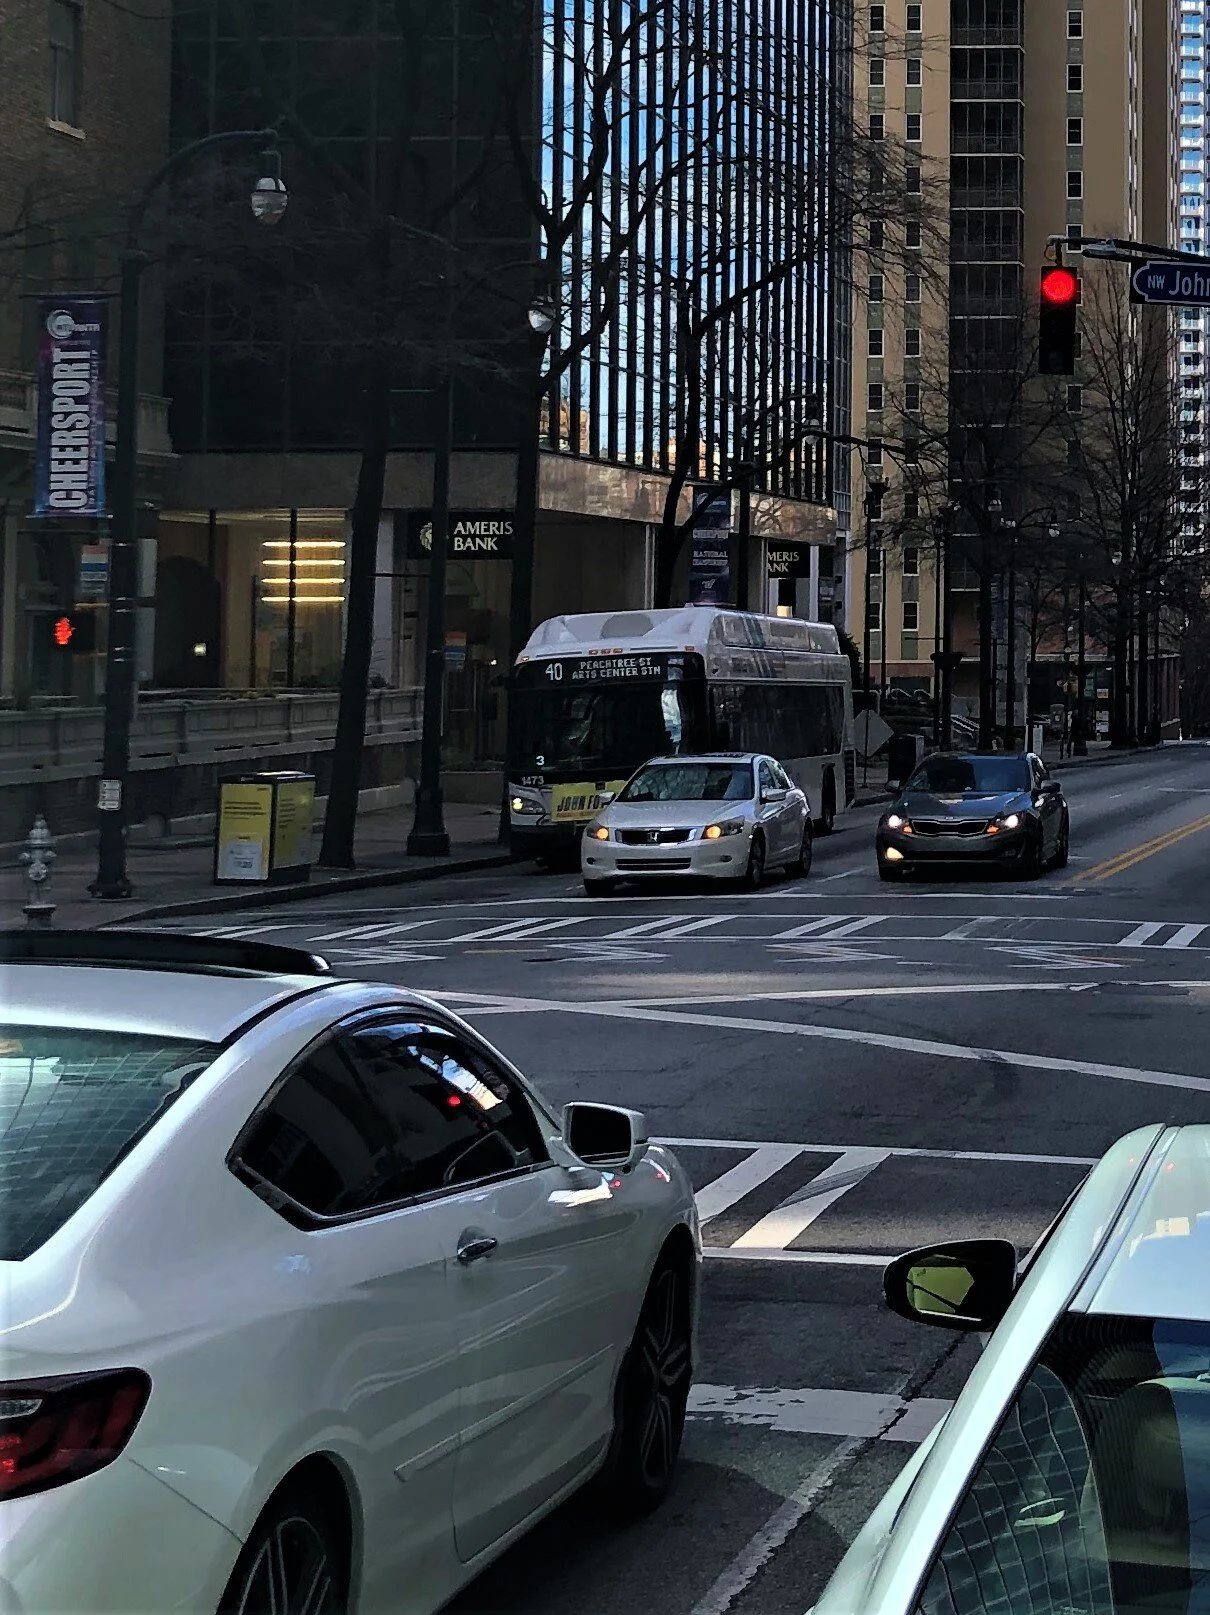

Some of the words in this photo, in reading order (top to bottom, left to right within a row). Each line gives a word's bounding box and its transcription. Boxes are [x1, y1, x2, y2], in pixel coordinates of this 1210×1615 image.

[1148, 274, 1166, 290] NW
[49, 347, 91, 508] CHEERSPORT
[454, 521, 513, 535] AMERIS
[454, 537, 498, 551] BANK
[766, 551, 799, 562] MERIS
[766, 563, 789, 572] ANK
[580, 658, 636, 670] PEACHTREE
[639, 657, 651, 667] ST
[545, 663, 563, 681] 40
[572, 670, 597, 680] ARTS
[600, 668, 638, 678] CENTER
[640, 666, 661, 676] STN
[536, 755, 545, 766] 3
[521, 776, 545, 785] 1473
[557, 795, 587, 812] JOHN
